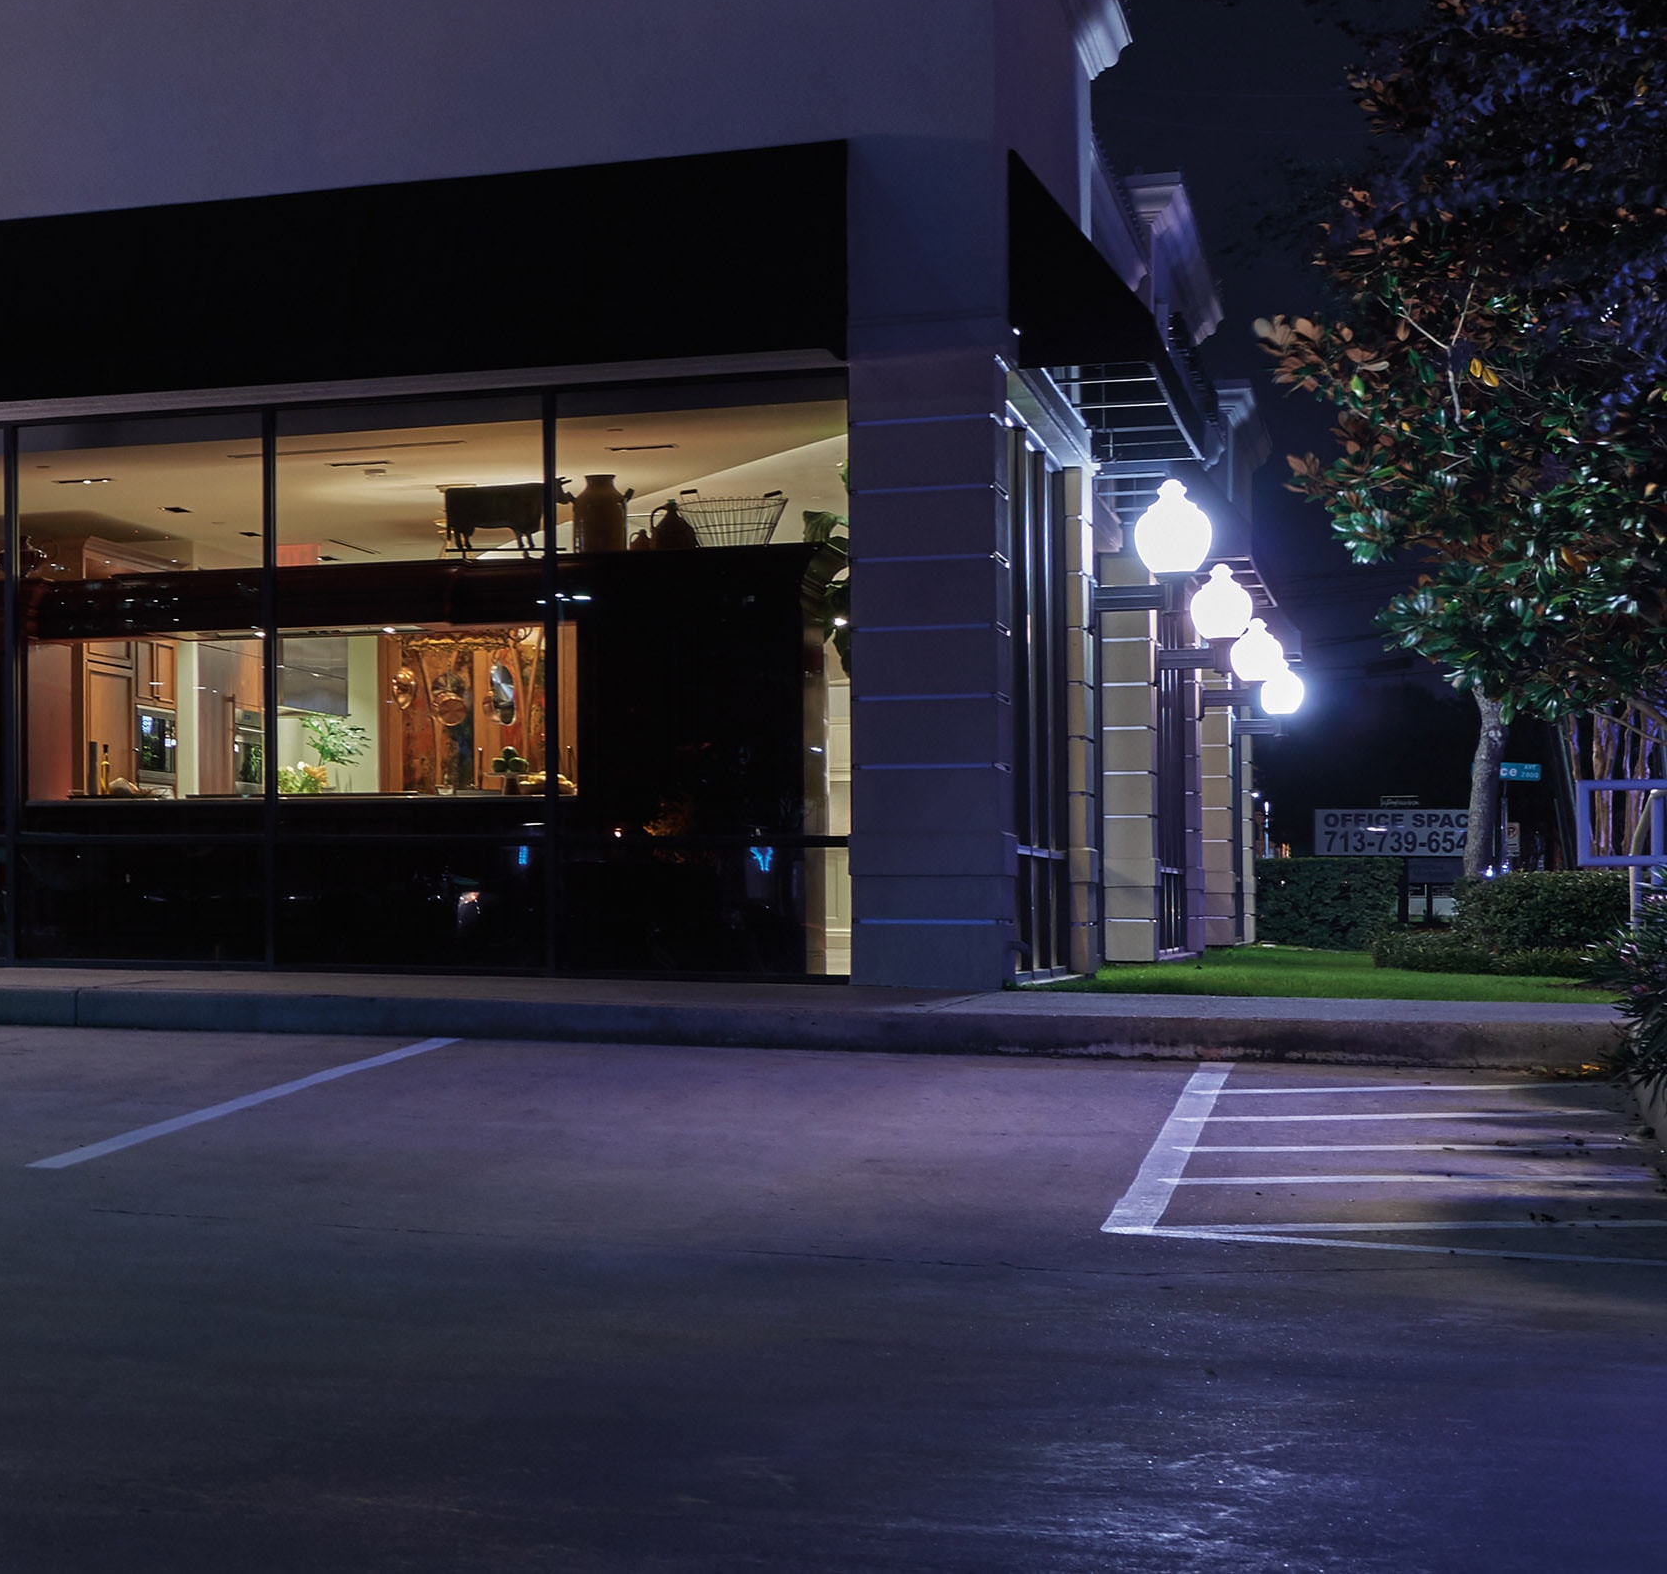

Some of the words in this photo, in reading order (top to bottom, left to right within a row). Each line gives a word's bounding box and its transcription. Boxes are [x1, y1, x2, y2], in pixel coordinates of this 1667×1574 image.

[1323, 812, 1405, 829] OFFICE
[1411, 812, 1469, 829] SPAC
[1323, 830, 1467, 854] 713-739-654
